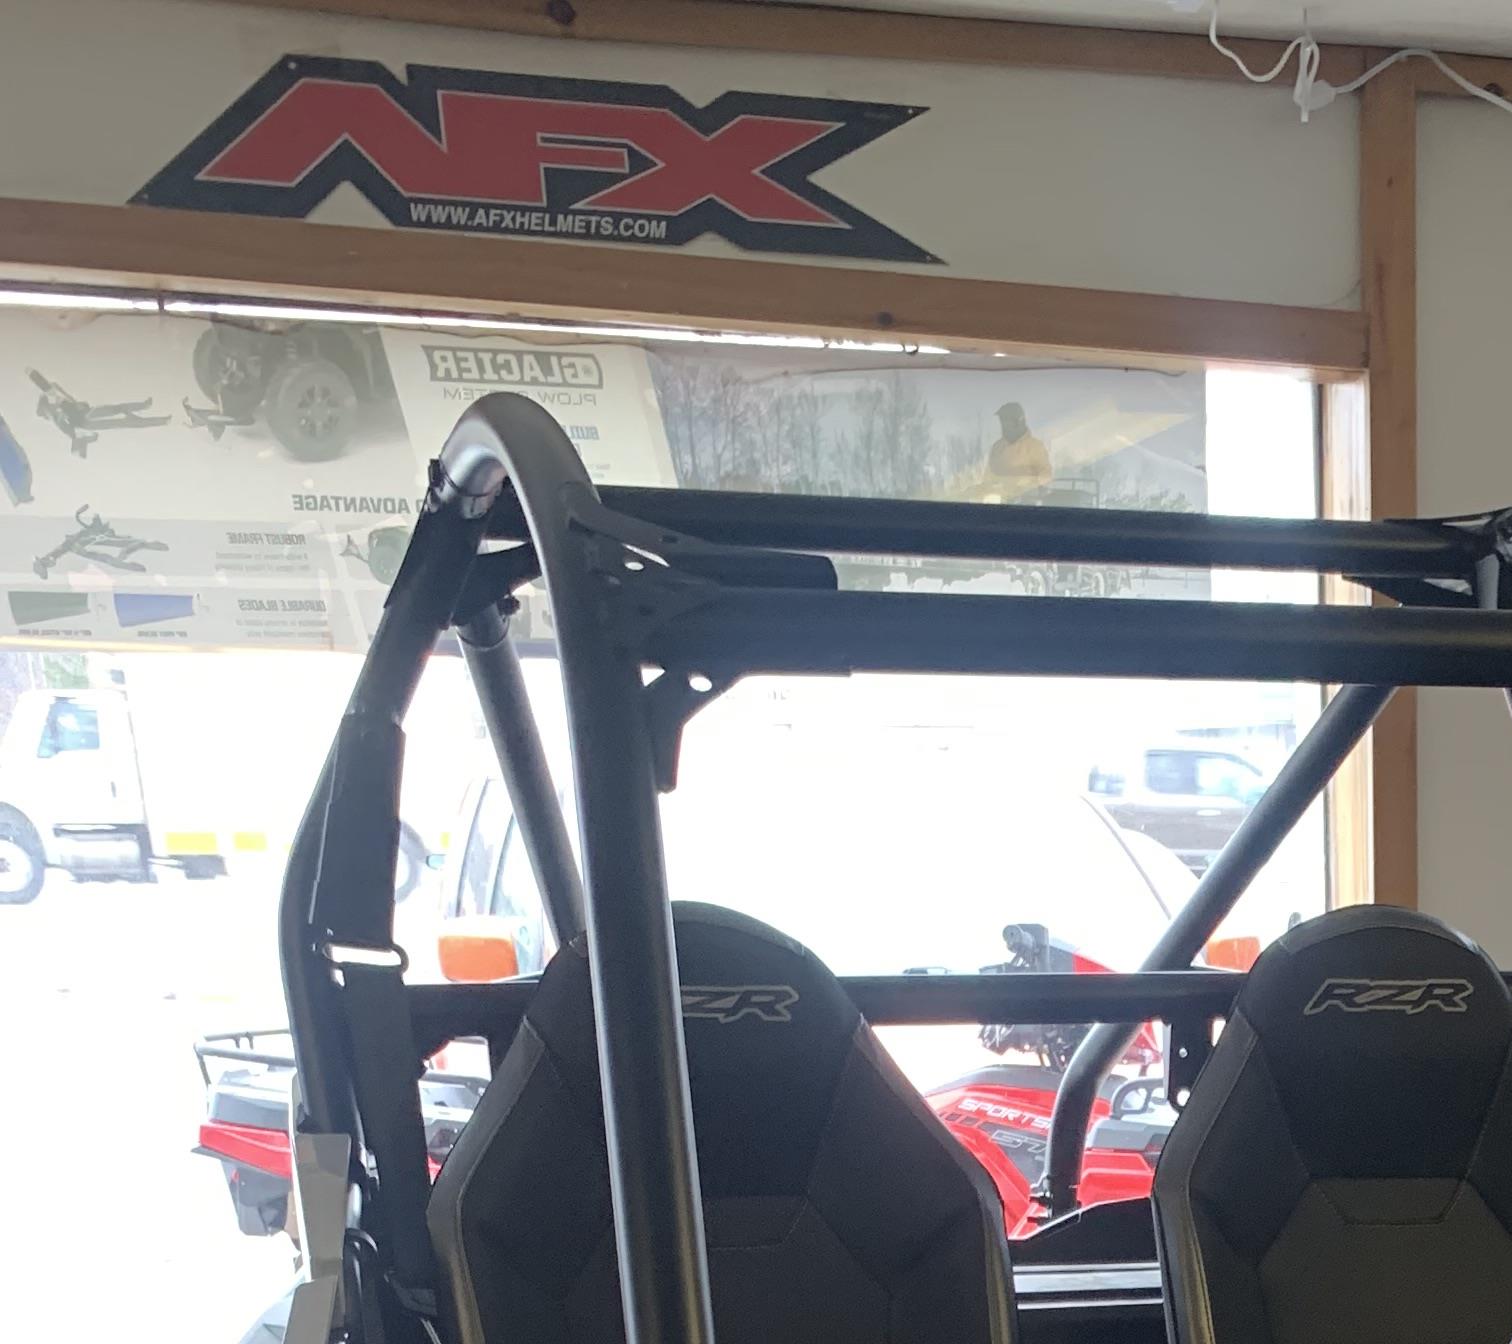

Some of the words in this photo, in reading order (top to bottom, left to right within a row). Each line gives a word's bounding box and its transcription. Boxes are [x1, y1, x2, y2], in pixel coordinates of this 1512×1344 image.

[409, 202, 668, 241] WWW.AFXHELMETS.COM
[680, 983, 801, 1024] ZR
[1303, 977, 1474, 1017] RZR
